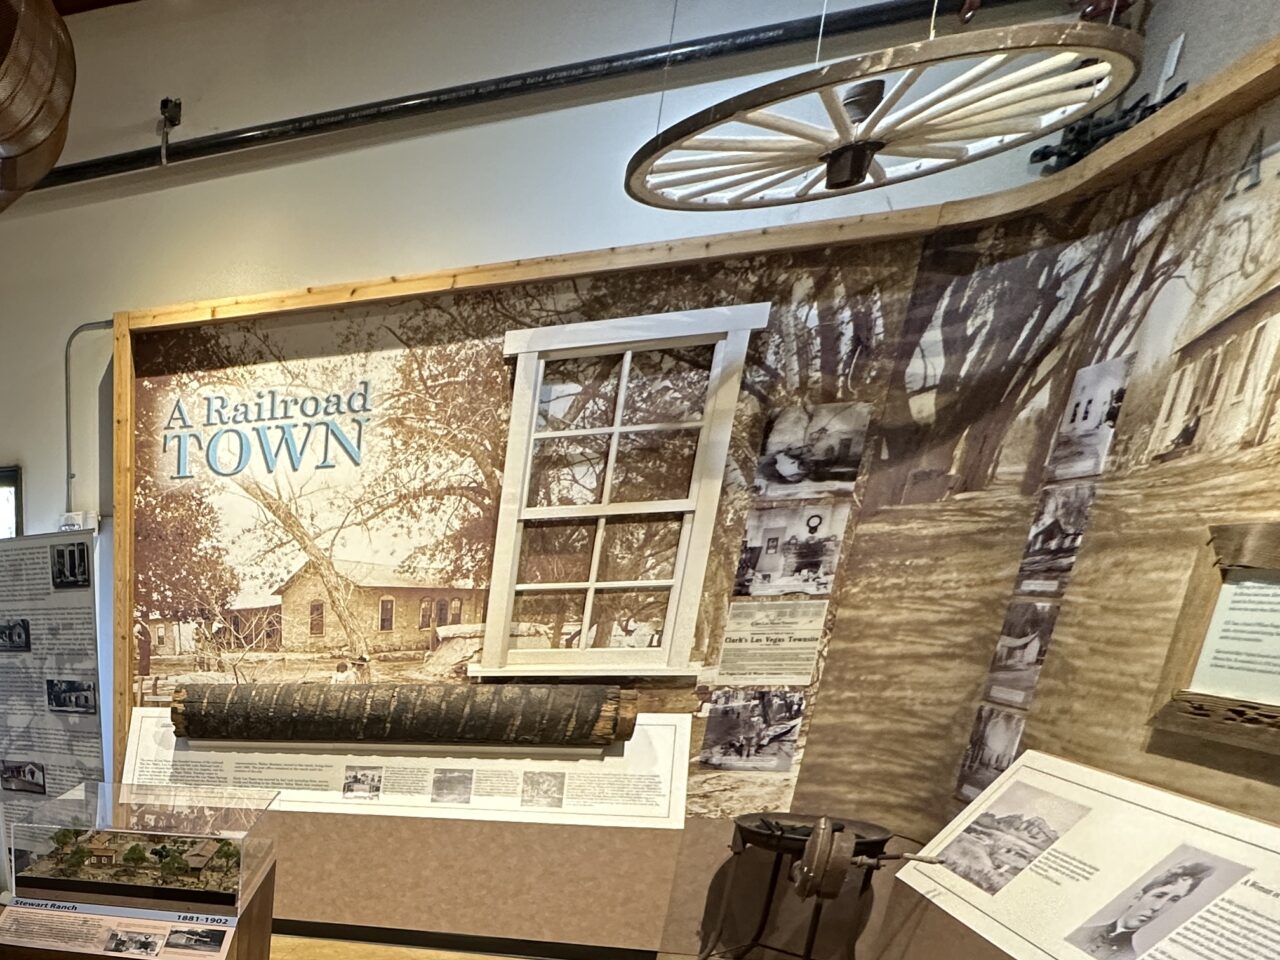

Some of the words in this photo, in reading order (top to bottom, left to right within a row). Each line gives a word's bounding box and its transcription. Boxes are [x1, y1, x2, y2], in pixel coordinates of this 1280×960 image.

[164, 399, 194, 431] A
[202, 381, 373, 428] Railroad
[161, 417, 372, 481] TOWN
[765, 636, 785, 644] Vegas
[14, 899, 49, 910] Stewart
[50, 902, 78, 911] Ranch
[176, 913, 229, 925] 1881-1902
